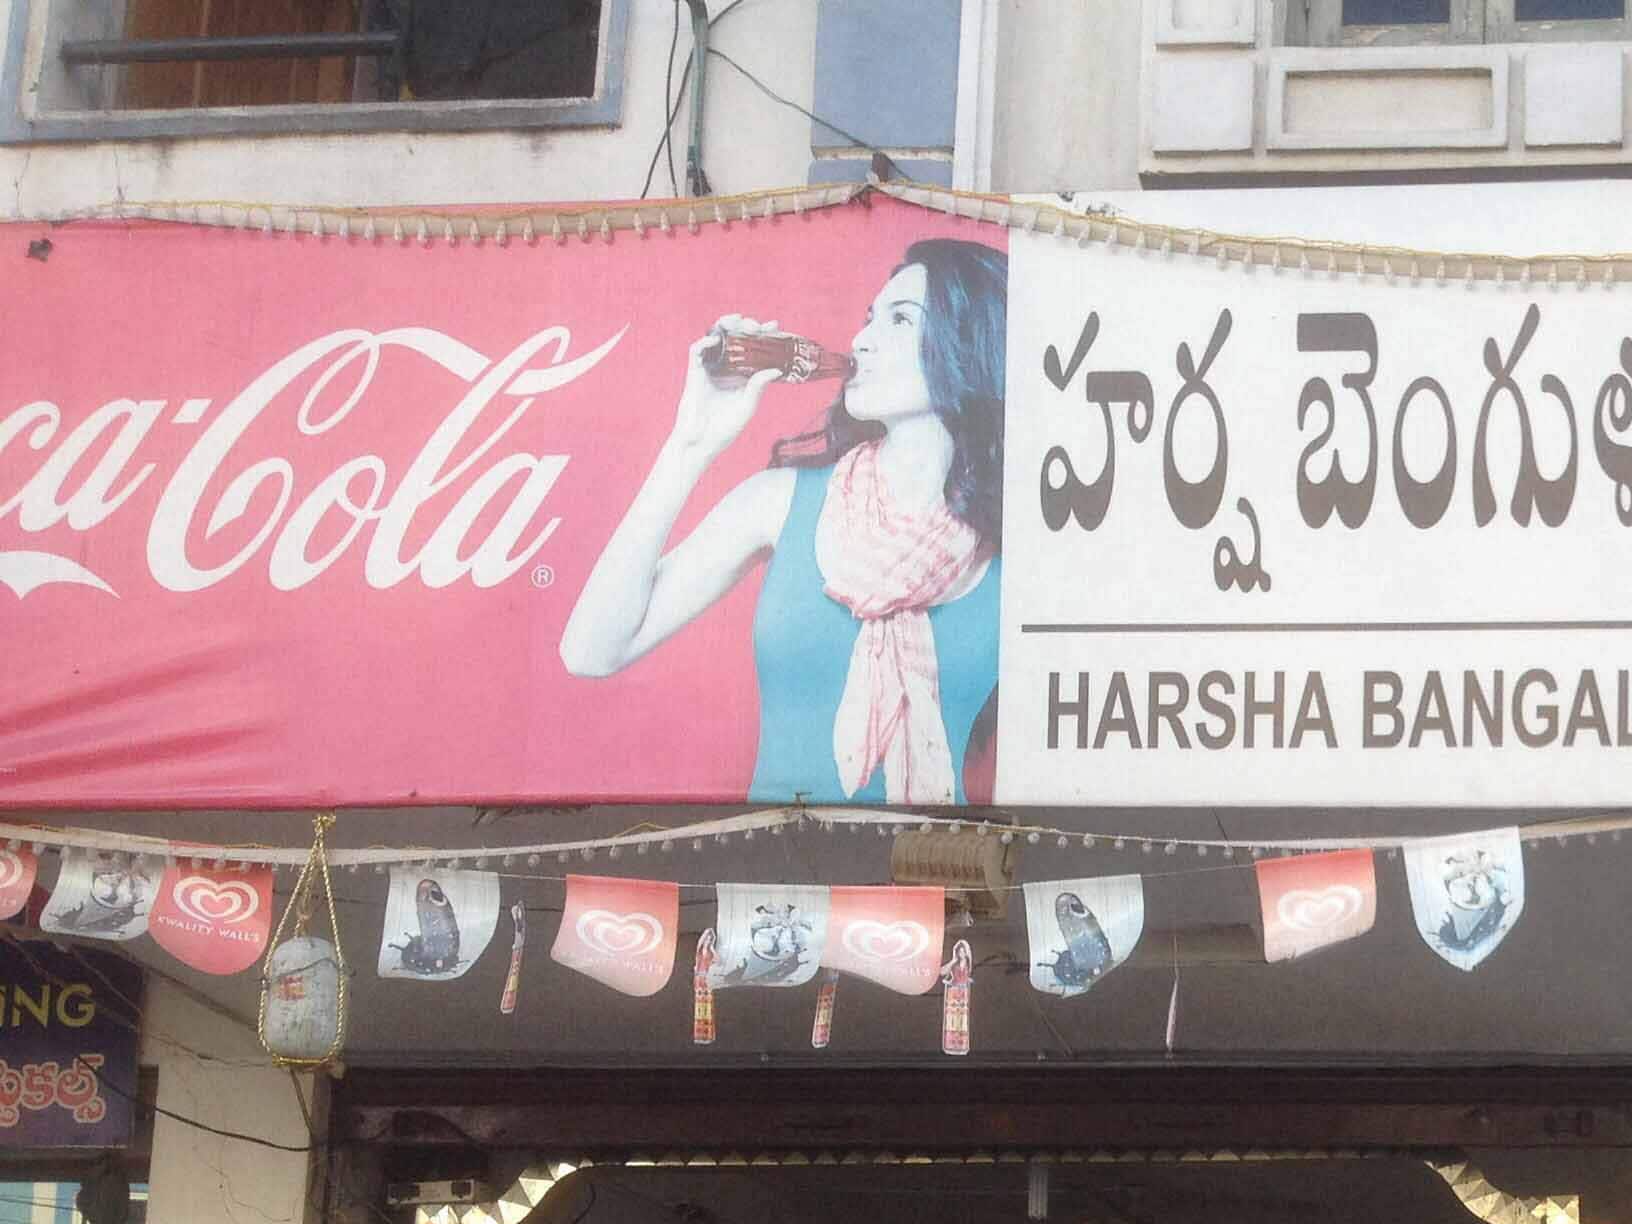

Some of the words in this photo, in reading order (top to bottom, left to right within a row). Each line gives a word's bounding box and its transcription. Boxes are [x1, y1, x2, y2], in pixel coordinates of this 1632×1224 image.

[0, 322, 630, 600] ca-Cola
[1046, 669, 1339, 750] HARSHA
[158, 914, 214, 937] KWALITY
[219, 927, 260, 944] WALL'S
